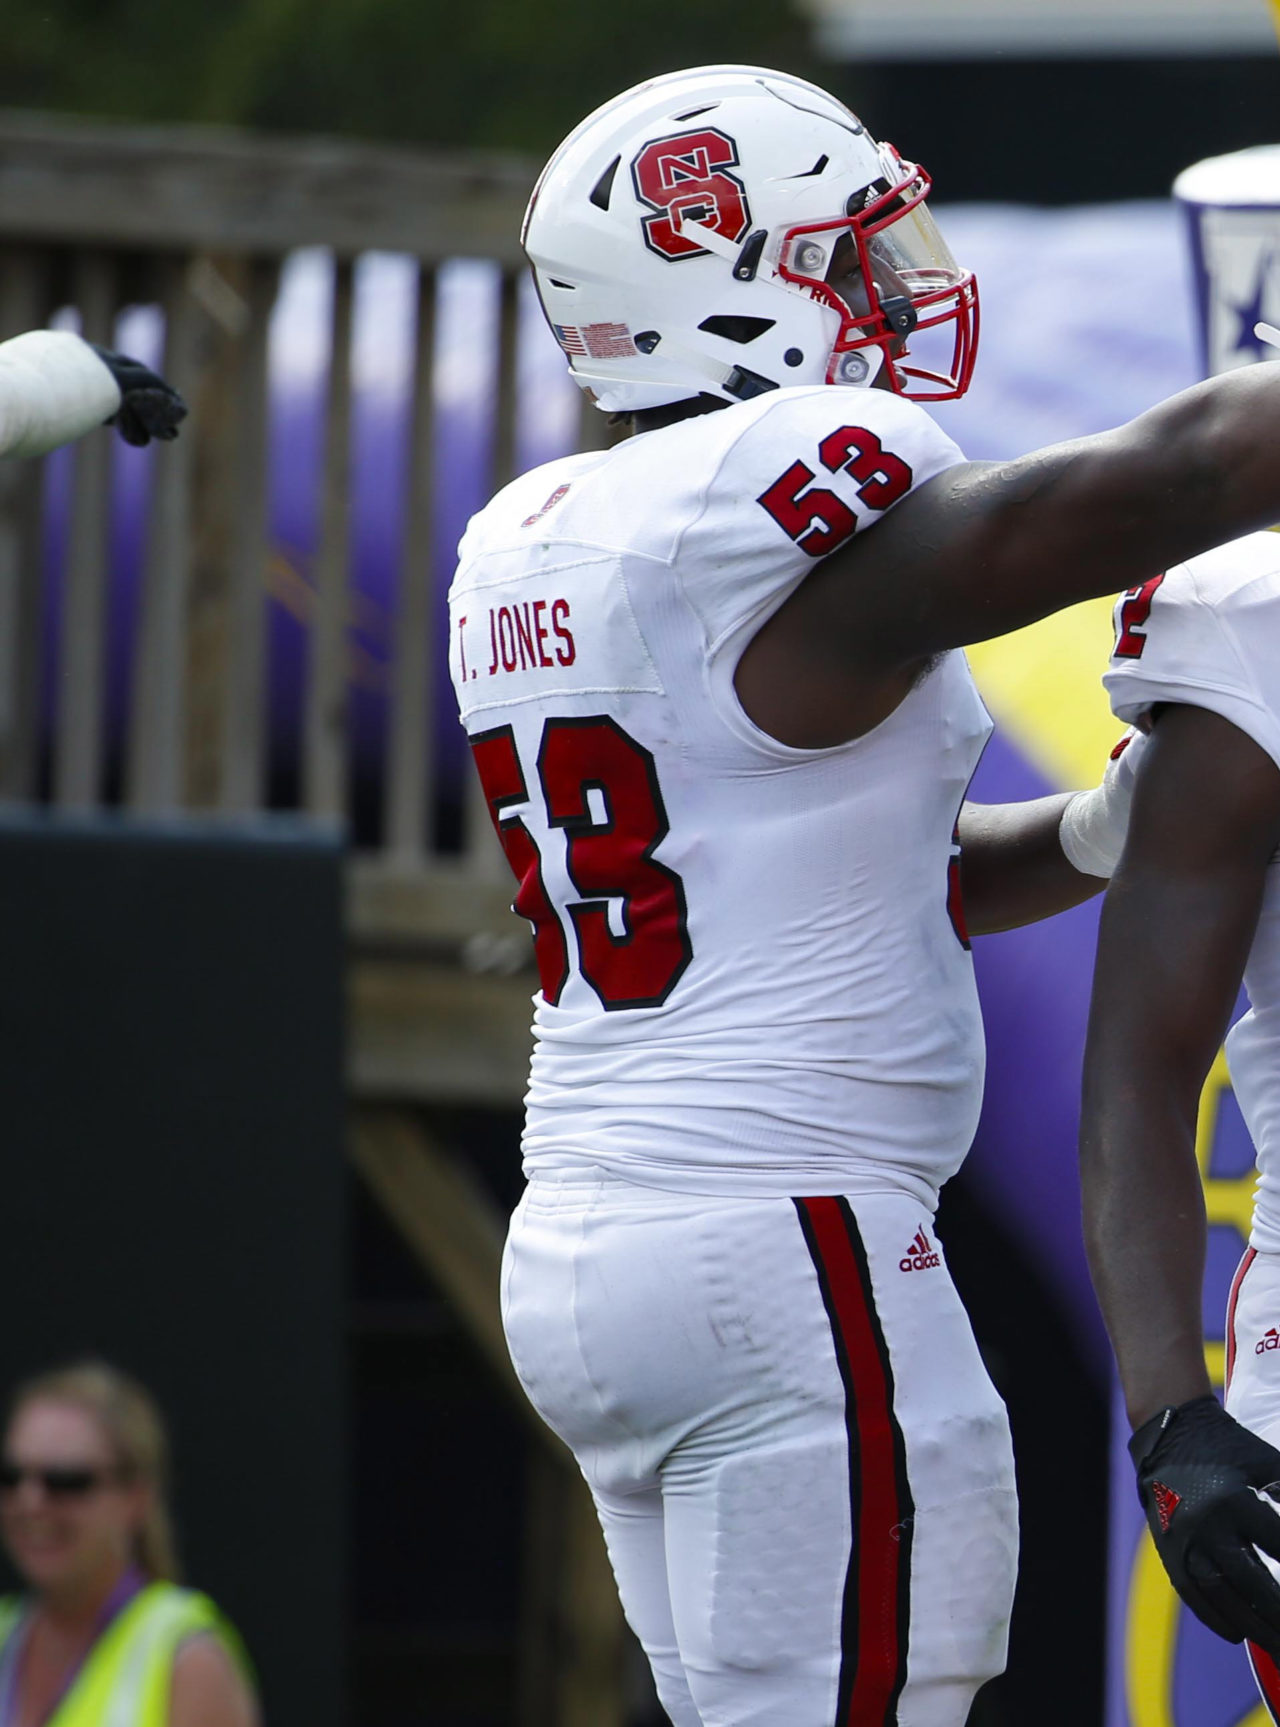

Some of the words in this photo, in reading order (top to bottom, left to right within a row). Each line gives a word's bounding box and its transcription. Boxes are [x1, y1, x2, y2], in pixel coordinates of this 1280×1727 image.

[757, 425, 913, 557] 53
[458, 616, 478, 682] T.
[488, 598, 577, 676] JONES
